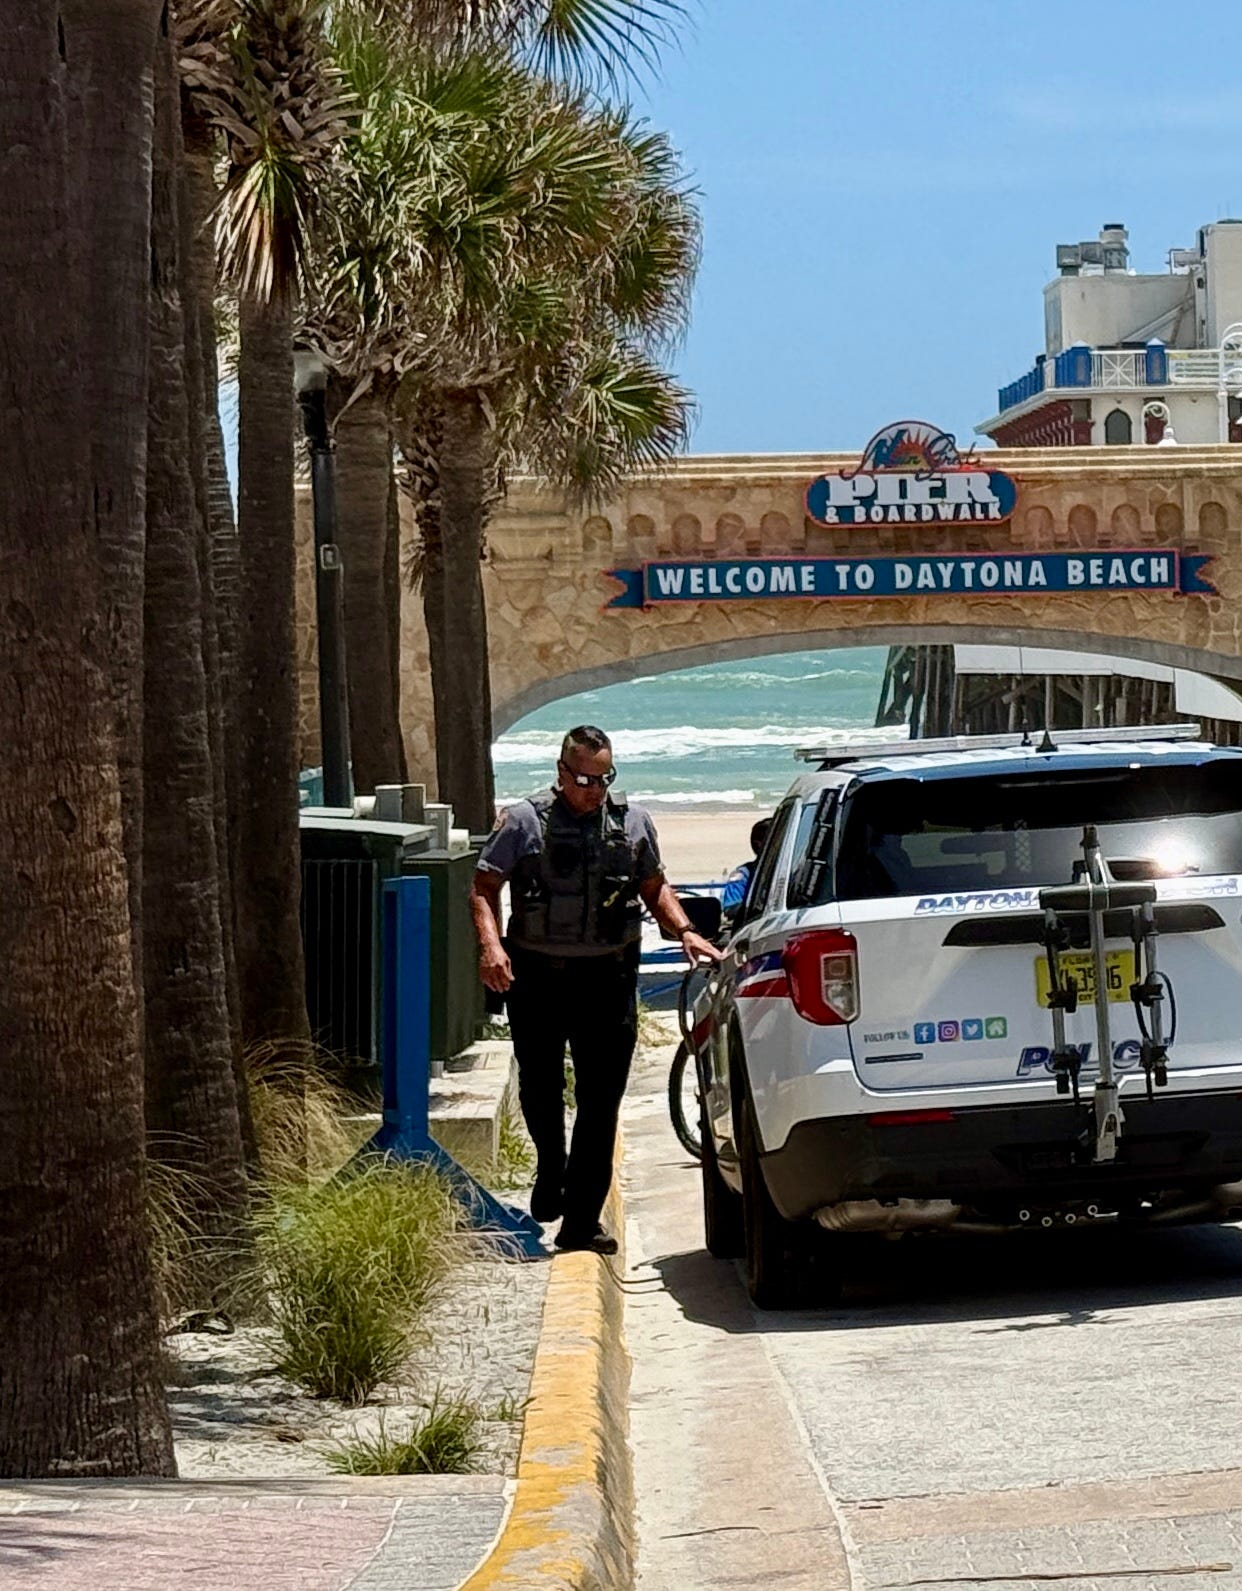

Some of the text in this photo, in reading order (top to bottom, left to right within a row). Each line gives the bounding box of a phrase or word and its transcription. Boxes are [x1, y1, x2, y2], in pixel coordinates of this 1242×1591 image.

[825, 473, 1001, 506] PIER
[825, 502, 1001, 523] & BOARDWALK
[656, 557, 1170, 595] WELCOME TO DAYTONA BEACH
[1018, 1038, 1173, 1076] PLC
